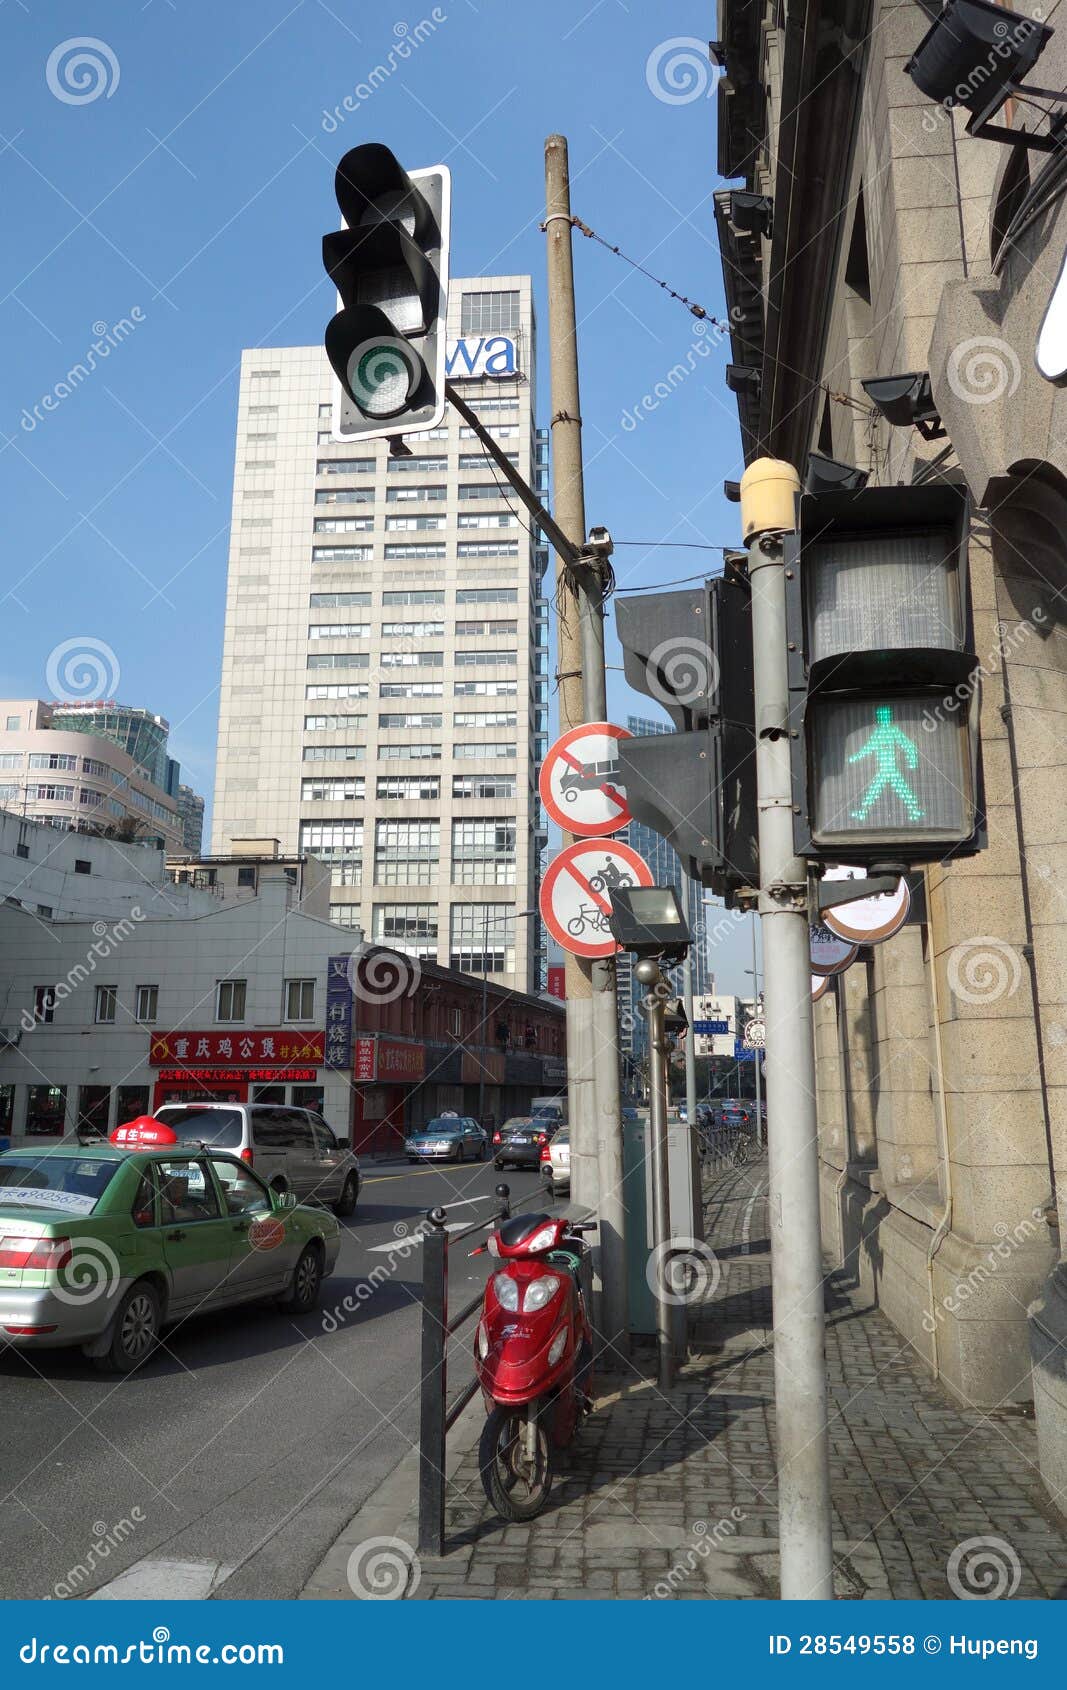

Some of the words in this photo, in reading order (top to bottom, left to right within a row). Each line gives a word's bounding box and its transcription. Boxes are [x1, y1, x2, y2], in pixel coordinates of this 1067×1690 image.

[174, 1037, 275, 1059] 重庆鸡公煲
